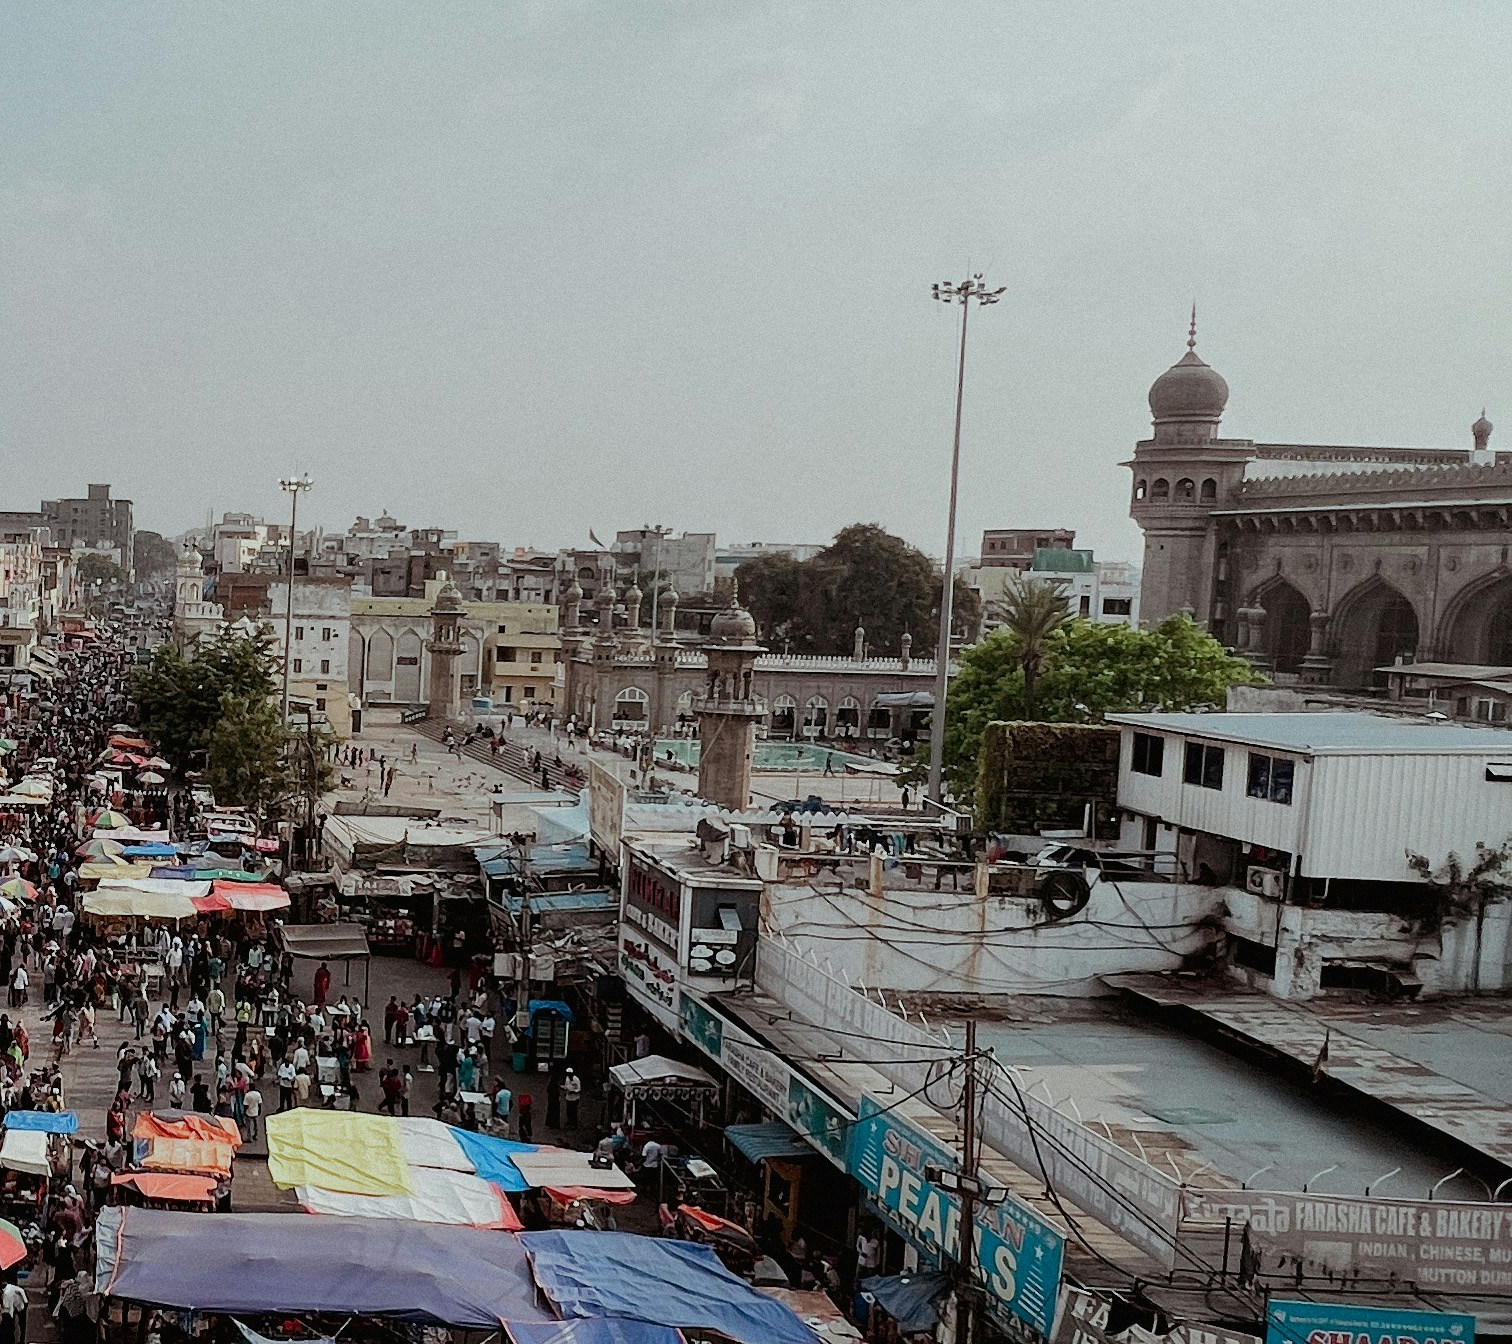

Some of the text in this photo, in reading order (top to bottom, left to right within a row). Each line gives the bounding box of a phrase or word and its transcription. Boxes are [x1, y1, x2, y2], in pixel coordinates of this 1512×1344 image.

[1296, 1202, 1375, 1234] FARASHA
[1375, 1205, 1416, 1236] CAFE
[1419, 1211, 1431, 1236] &
[1436, 1209, 1504, 1239] BAKERY
